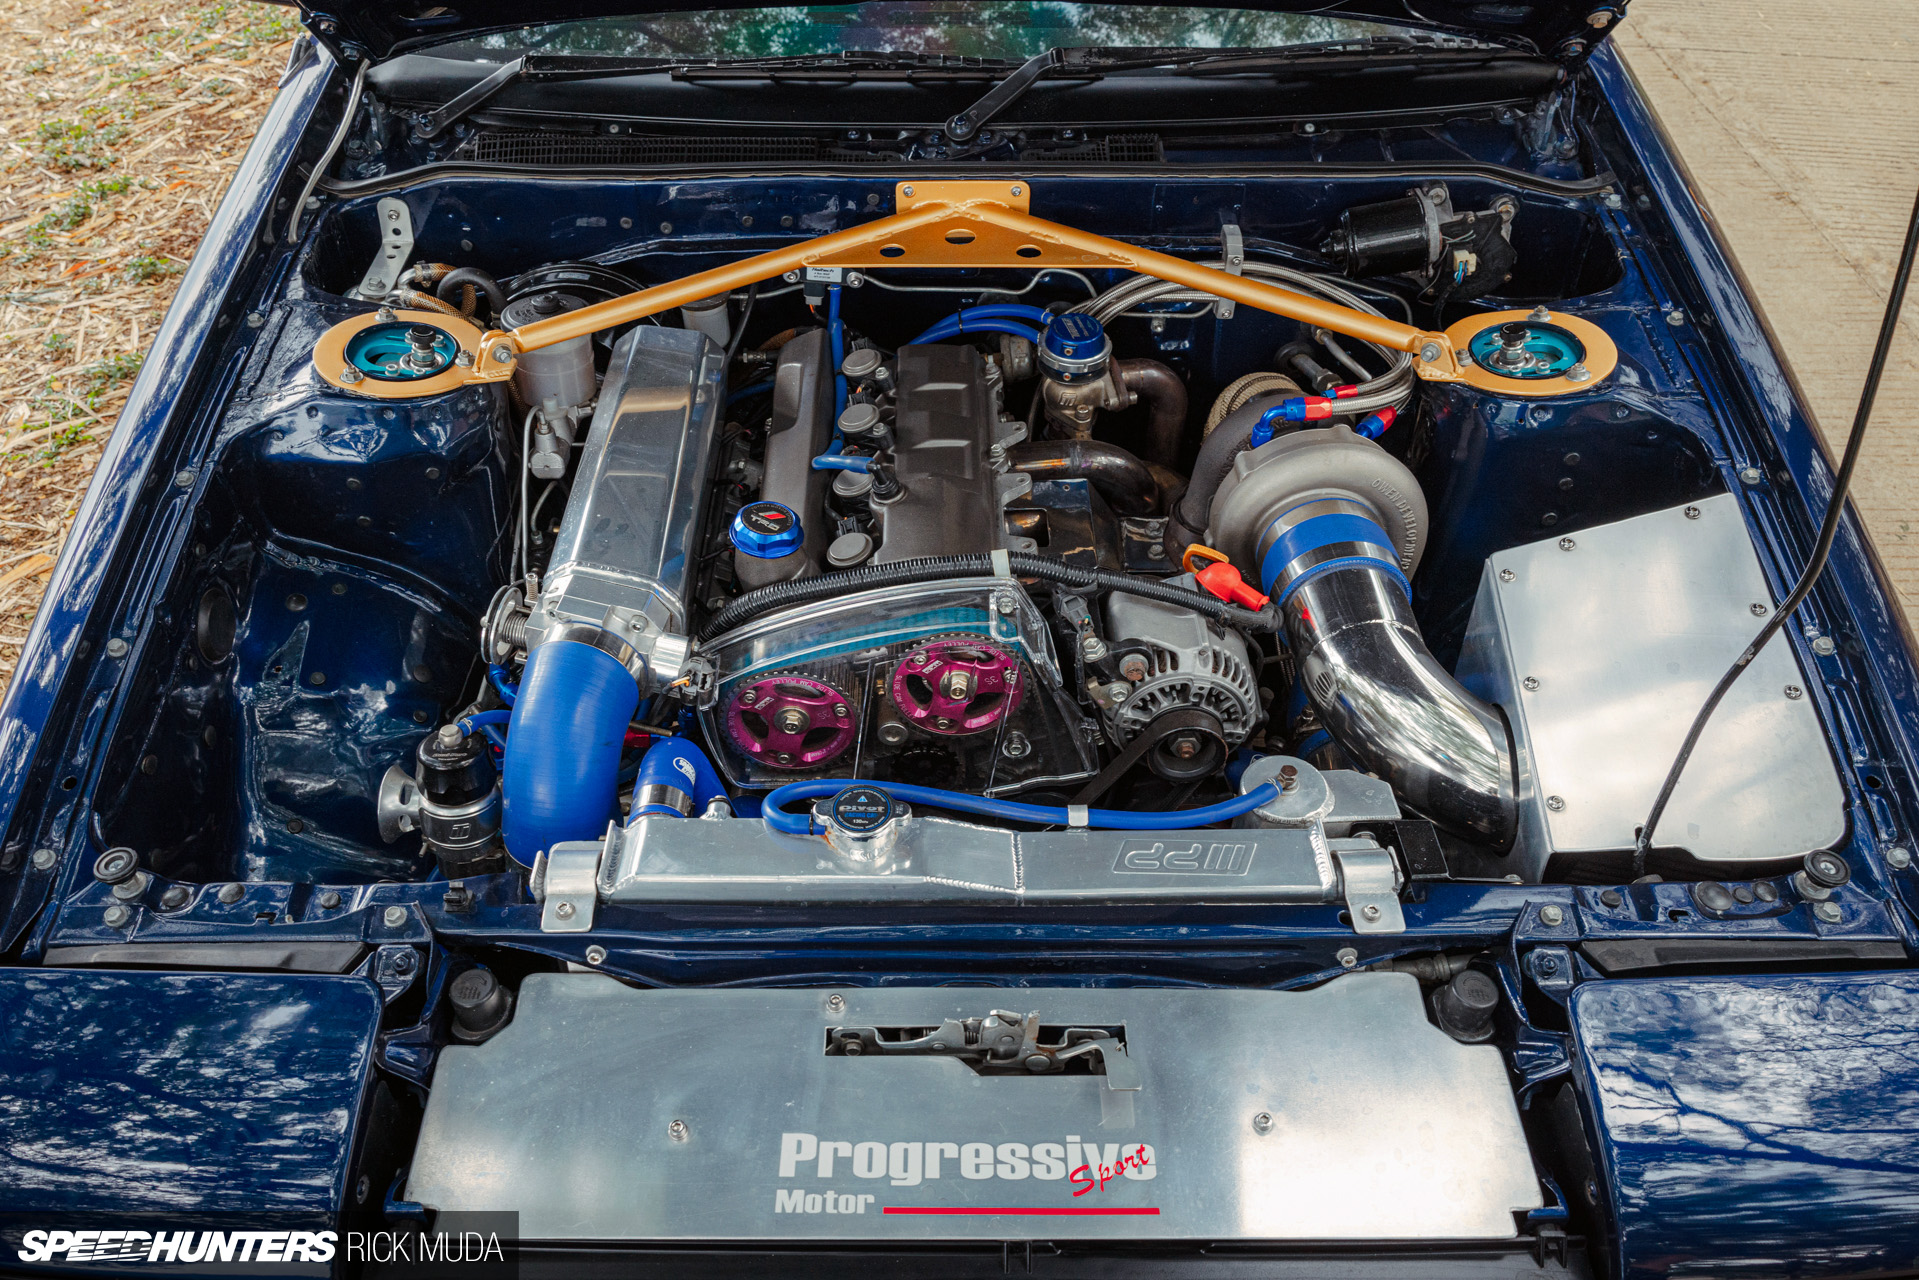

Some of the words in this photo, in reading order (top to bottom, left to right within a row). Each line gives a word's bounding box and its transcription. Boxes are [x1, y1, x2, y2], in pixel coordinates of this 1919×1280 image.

[1371, 478, 1402, 502] OWEN
[750, 514, 780, 531] TRD
[778, 1133, 1157, 1187] Progressive
[1069, 1144, 1150, 1198] Sport
[775, 1190, 875, 1214] Motor
